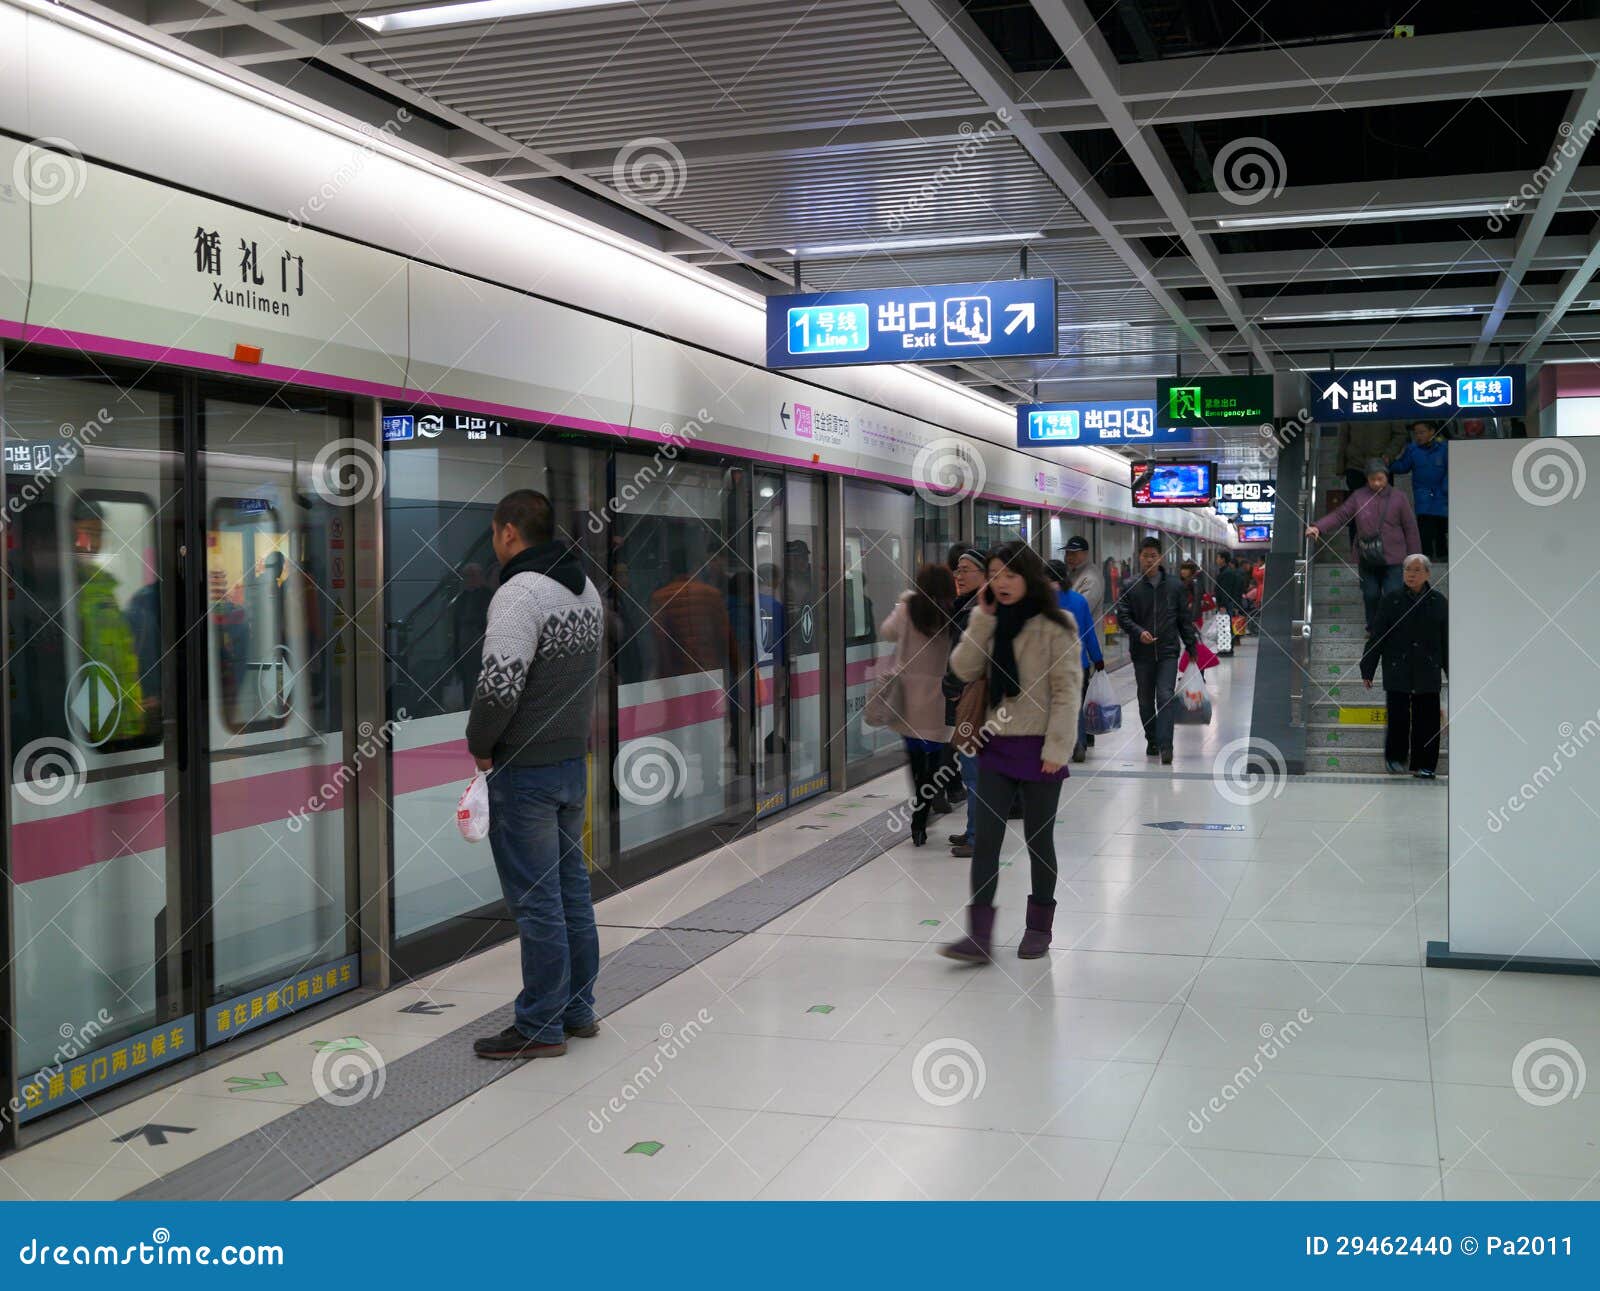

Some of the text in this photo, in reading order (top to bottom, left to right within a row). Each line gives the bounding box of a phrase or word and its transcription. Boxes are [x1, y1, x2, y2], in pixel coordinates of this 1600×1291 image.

[194, 226, 304, 296] 循礼门
[213, 282, 290, 317] Xunlimen
[878, 302, 936, 331] 出口
[816, 334, 848, 347] Line
[903, 334, 936, 348] Exit
[1352, 379, 1396, 401] 出口
[1474, 394, 1495, 403] Line
[1205, 410, 1245, 418] Emergency
[1352, 402, 1378, 413] Exit
[1085, 409, 1121, 428] 出口
[1100, 428, 1121, 438] Exit
[217, 964, 351, 1032] 请在屏蔽门两边候车
